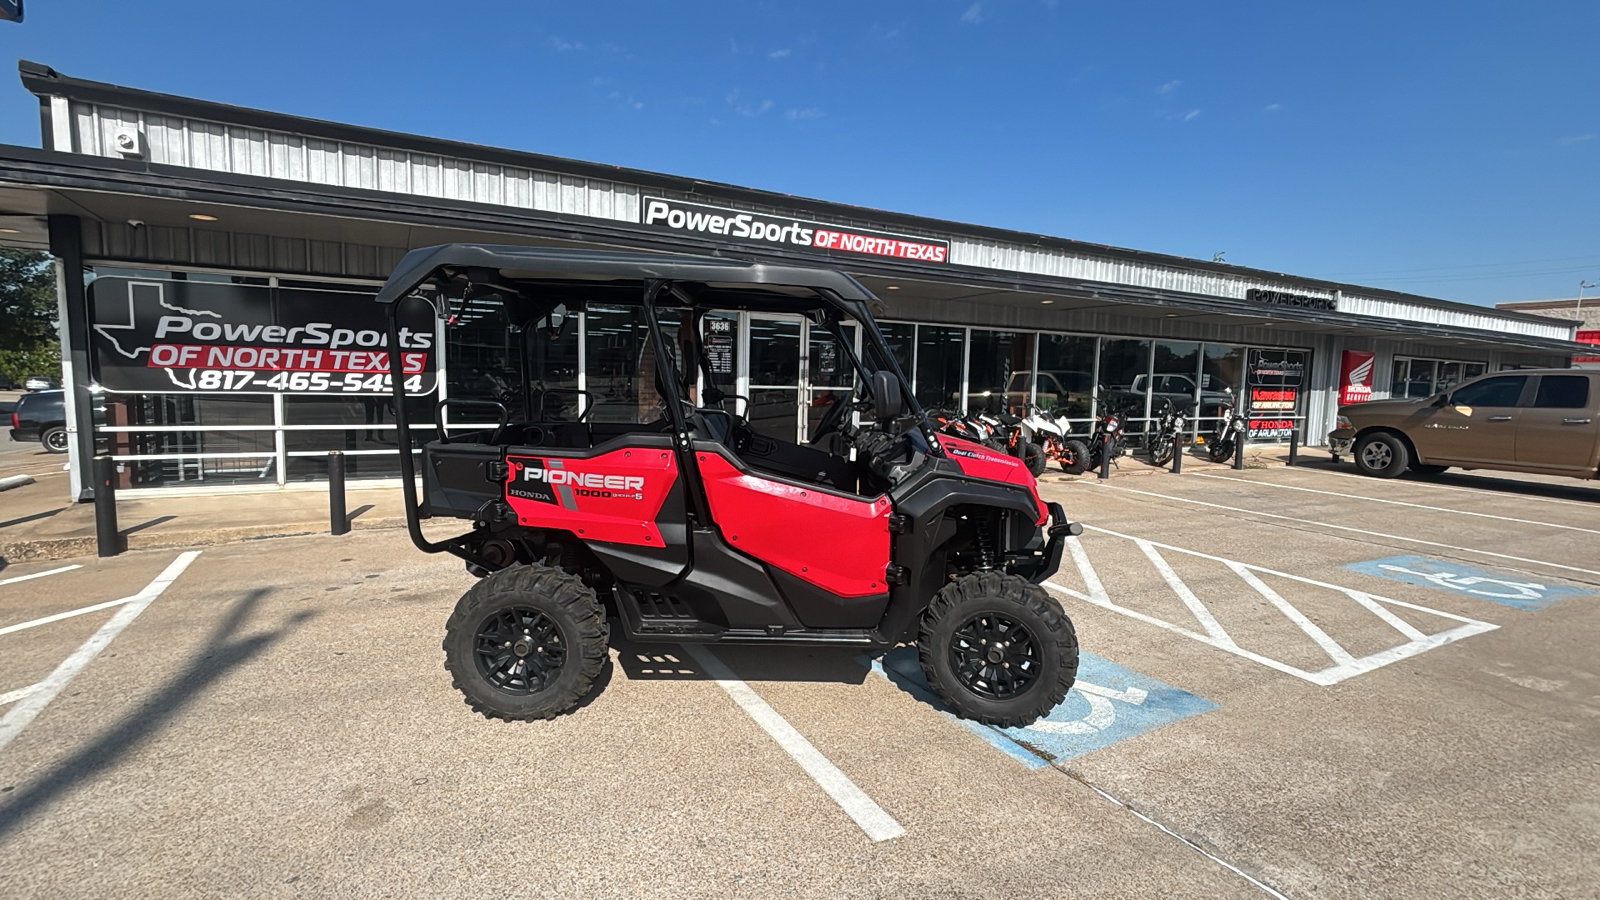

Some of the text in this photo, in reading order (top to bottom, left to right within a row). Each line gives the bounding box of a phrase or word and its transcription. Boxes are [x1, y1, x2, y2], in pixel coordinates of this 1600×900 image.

[646, 201, 945, 263] PowerSports OF NORTH TEXAS
[151, 345, 202, 366] OF
[207, 347, 321, 370] NORTH
[1252, 387, 1296, 401] Kawasaki
[1347, 385, 1372, 393] HONDA
[1261, 420, 1293, 429] HONDA
[1248, 429, 1259, 438] OF
[952, 449, 967, 457] Dual
[967, 451, 985, 460] Clutch
[524, 467, 645, 491] PIONEER
[510, 489, 551, 501] HONDA
[575, 488, 612, 498] 1000
